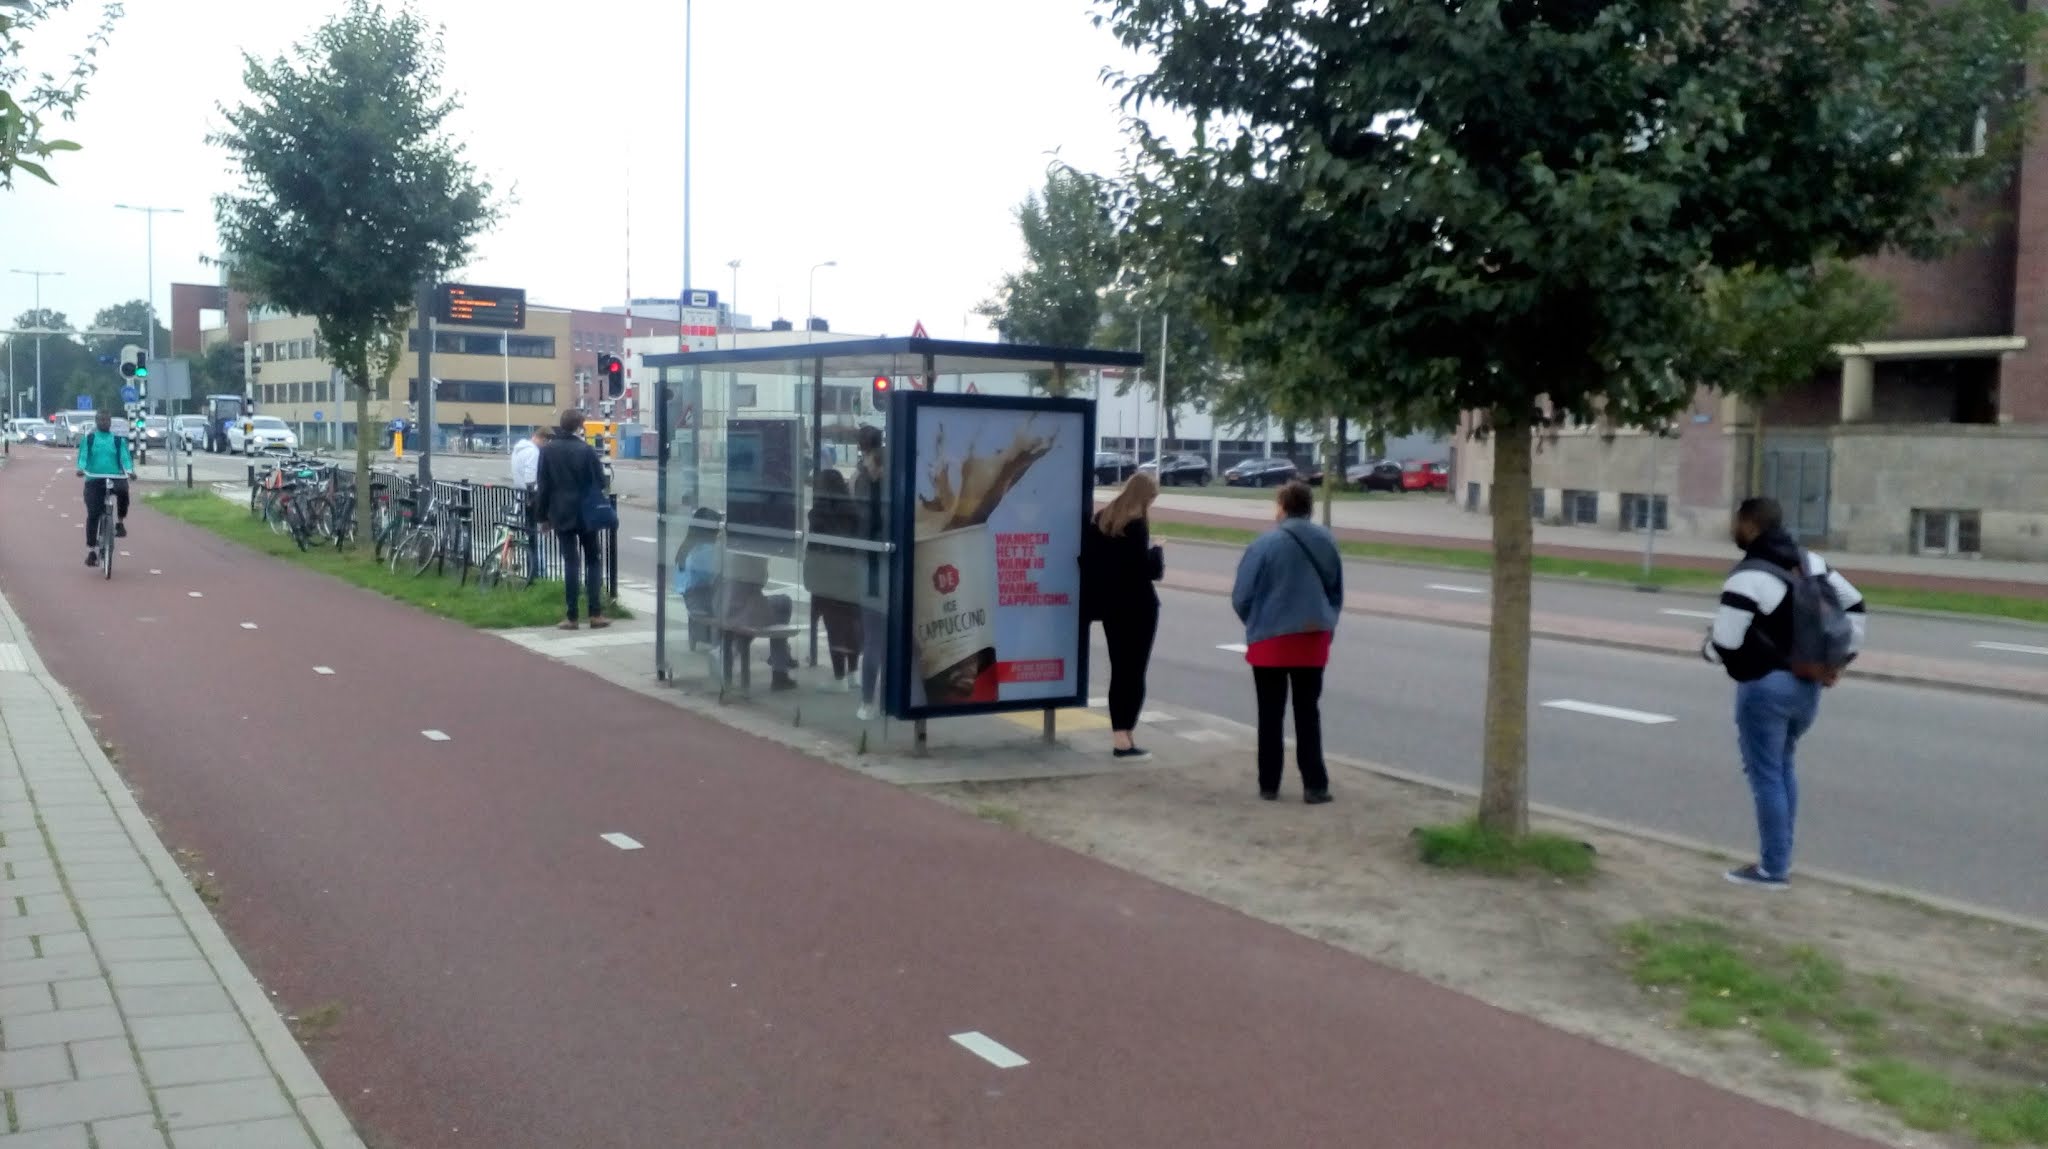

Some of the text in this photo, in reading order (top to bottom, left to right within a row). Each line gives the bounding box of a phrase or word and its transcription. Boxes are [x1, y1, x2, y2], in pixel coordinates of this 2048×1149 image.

[995, 533, 1049, 545] WANNEER
[997, 546, 1018, 557] HET
[997, 558, 1031, 569] WARM
[938, 572, 956, 588] DE
[998, 570, 1026, 582] VOOR
[999, 582, 1038, 594] WARME
[919, 608, 986, 641] CAPPUCCINO
